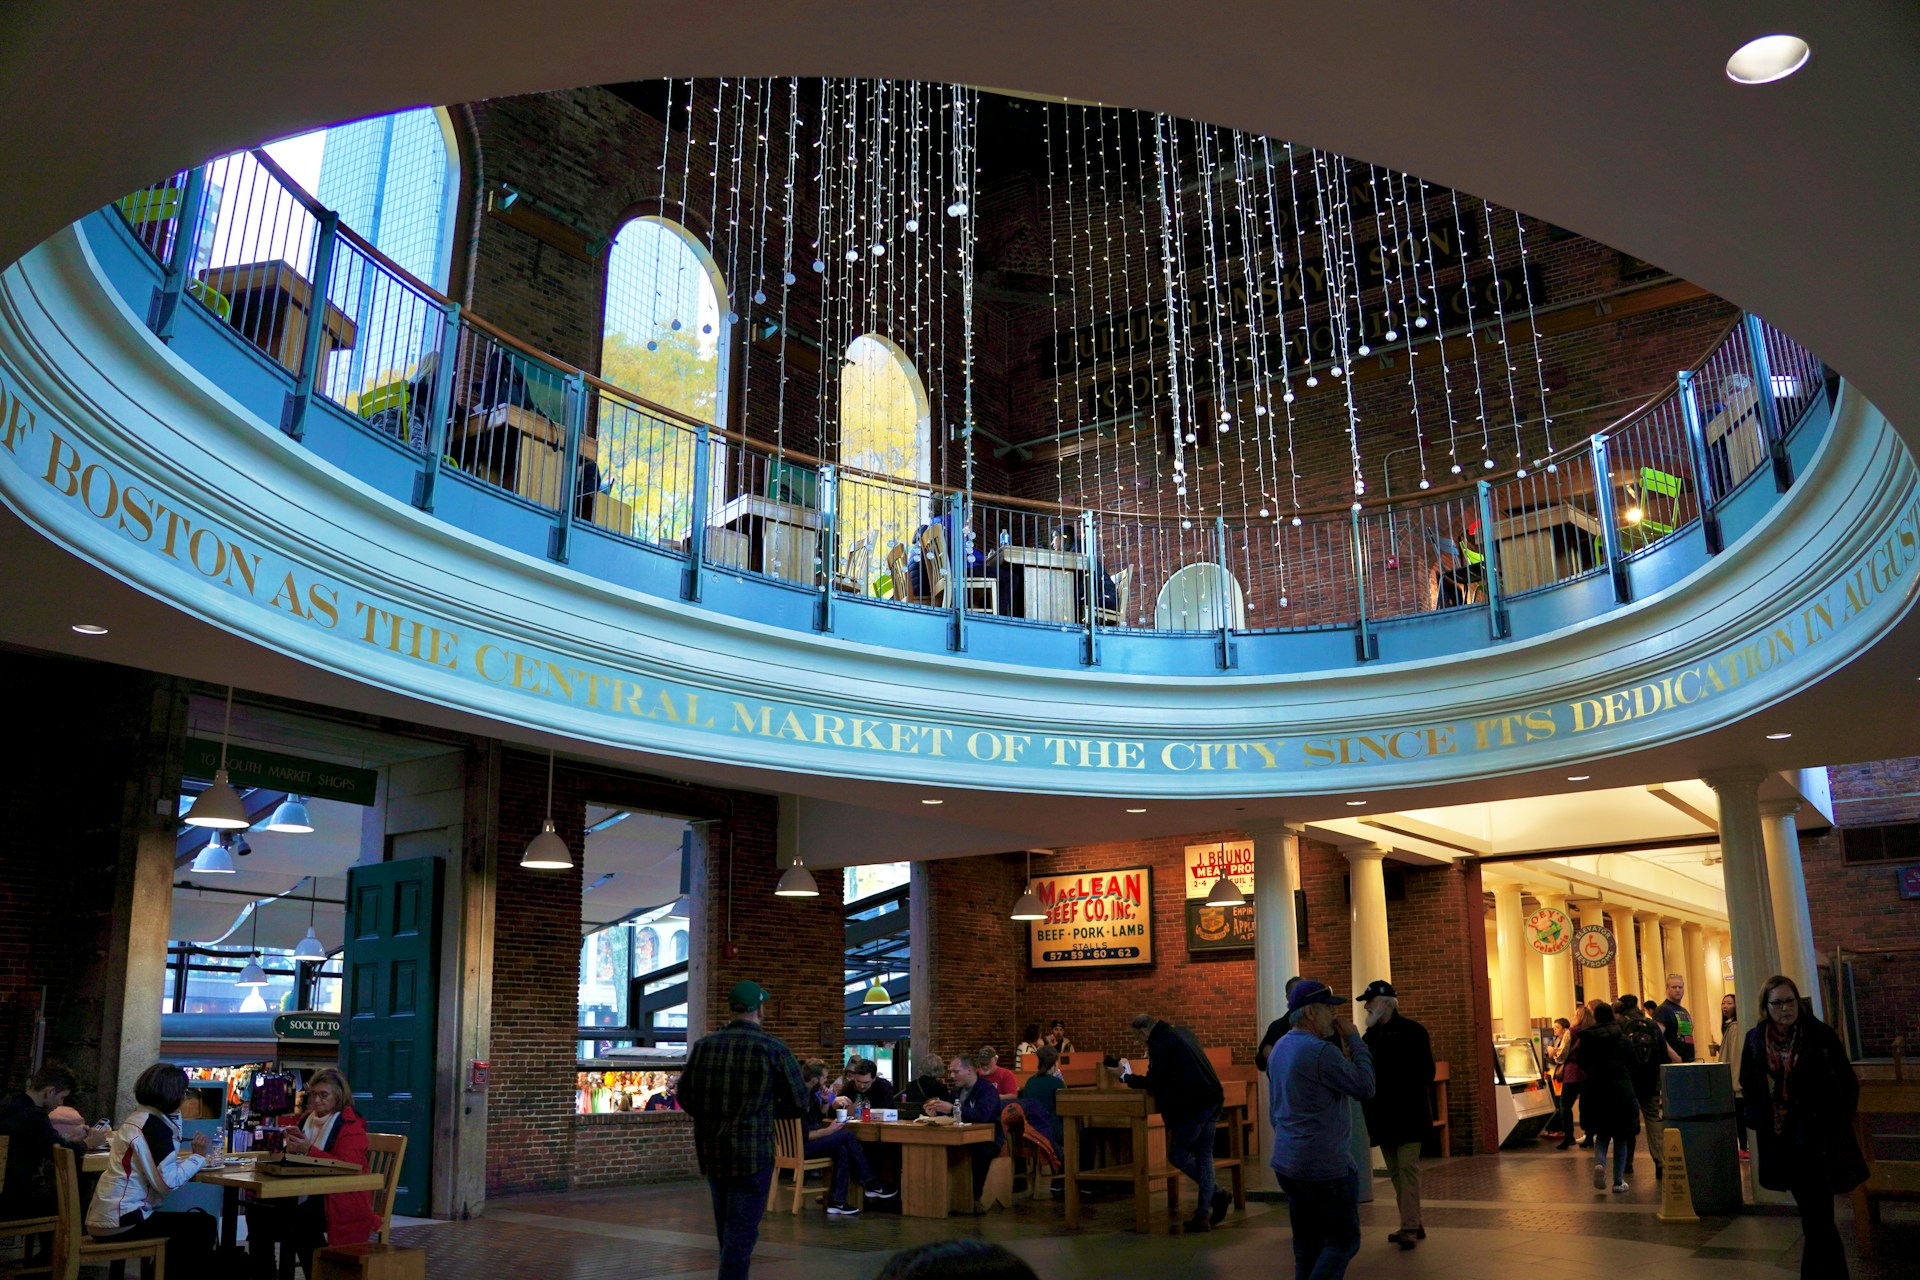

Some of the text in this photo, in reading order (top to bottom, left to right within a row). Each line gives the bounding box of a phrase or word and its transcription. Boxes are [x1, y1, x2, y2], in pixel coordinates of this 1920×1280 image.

[0, 376, 36, 456] F
[42, 429, 262, 596] BOSTON
[271, 571, 339, 629] AS
[355, 601, 459, 670] THE
[475, 644, 716, 728] CENTRAL
[730, 701, 953, 758] MARKET
[967, 731, 1031, 763] OF
[1045, 737, 1146, 769] THE
[1161, 741, 1286, 772] CITY
[1304, 726, 1458, 767] SINCE
[1472, 708, 1556, 750] ITS
[1569, 622, 1796, 733] DEDICATION
[1801, 593, 1834, 648] IN
[199, 752, 356, 791] TO SOUTH MARKET SHOPS
[1208, 848, 1251, 866] BRUNO
[1044, 900, 1079, 924] BEEF
[1037, 924, 1145, 941] BEEF PORK LAMB
[1576, 926, 1611, 940] ELEVATOR
[1073, 941, 1108, 950] STALLS
[1050, 948, 1132, 961] 57 59 60 62
[1575, 950, 1614, 967] RESTROOMS
[290, 1020, 340, 1031] SOCK IT TO
[313, 1029, 331, 1037] Boston
